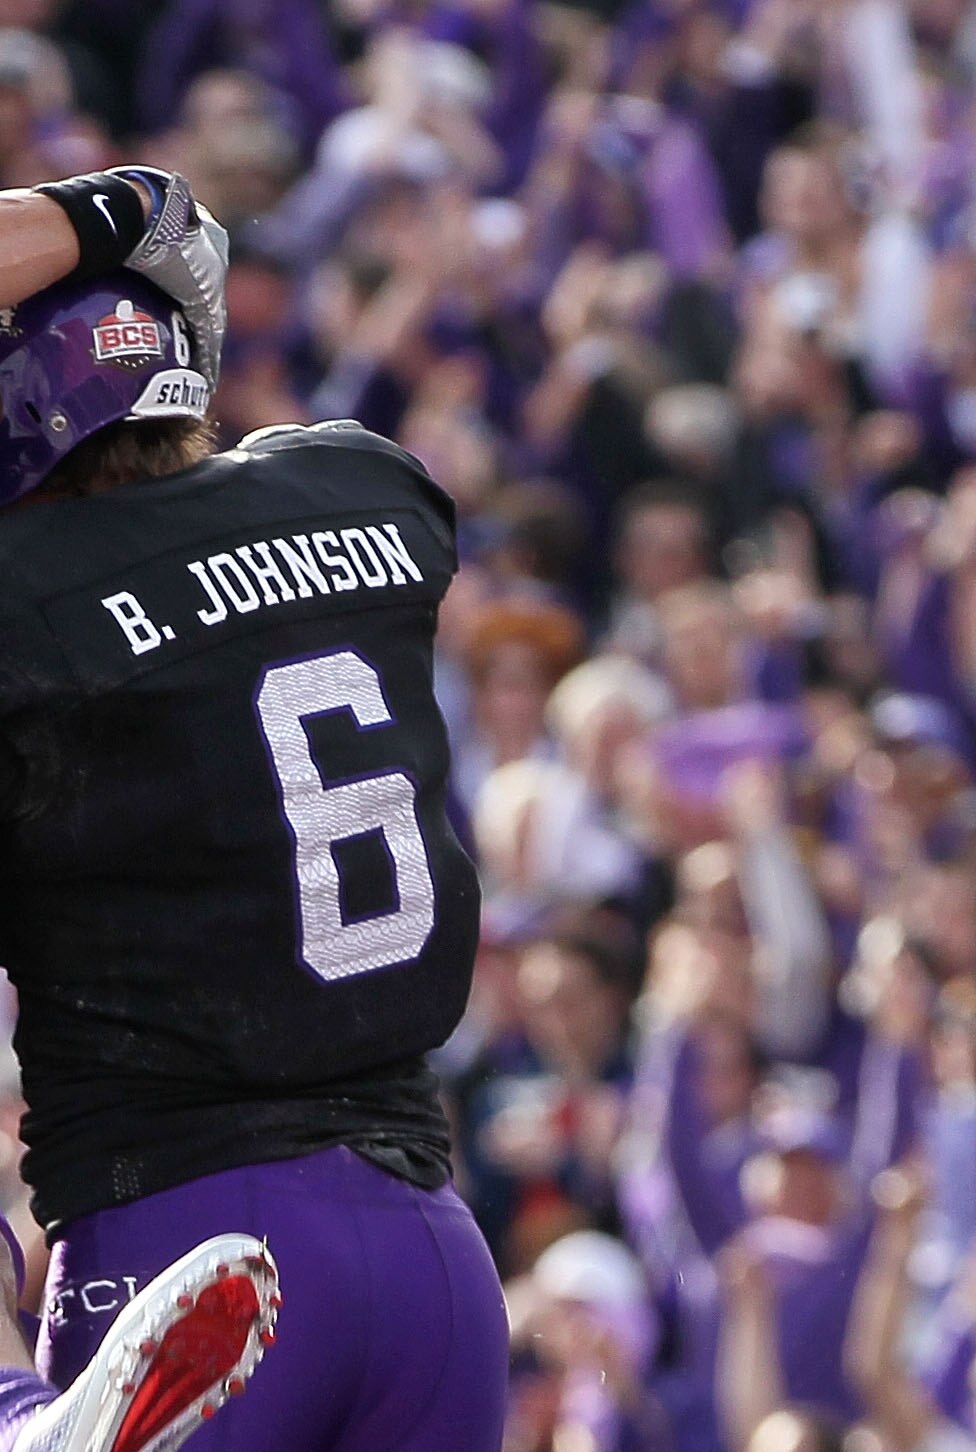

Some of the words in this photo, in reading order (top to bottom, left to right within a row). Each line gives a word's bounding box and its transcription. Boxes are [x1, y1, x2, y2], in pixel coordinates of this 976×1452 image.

[99, 324, 159, 350] BCS
[102, 591, 176, 656] B.
[188, 524, 423, 626] JOHNSON
[257, 651, 435, 982] 6
